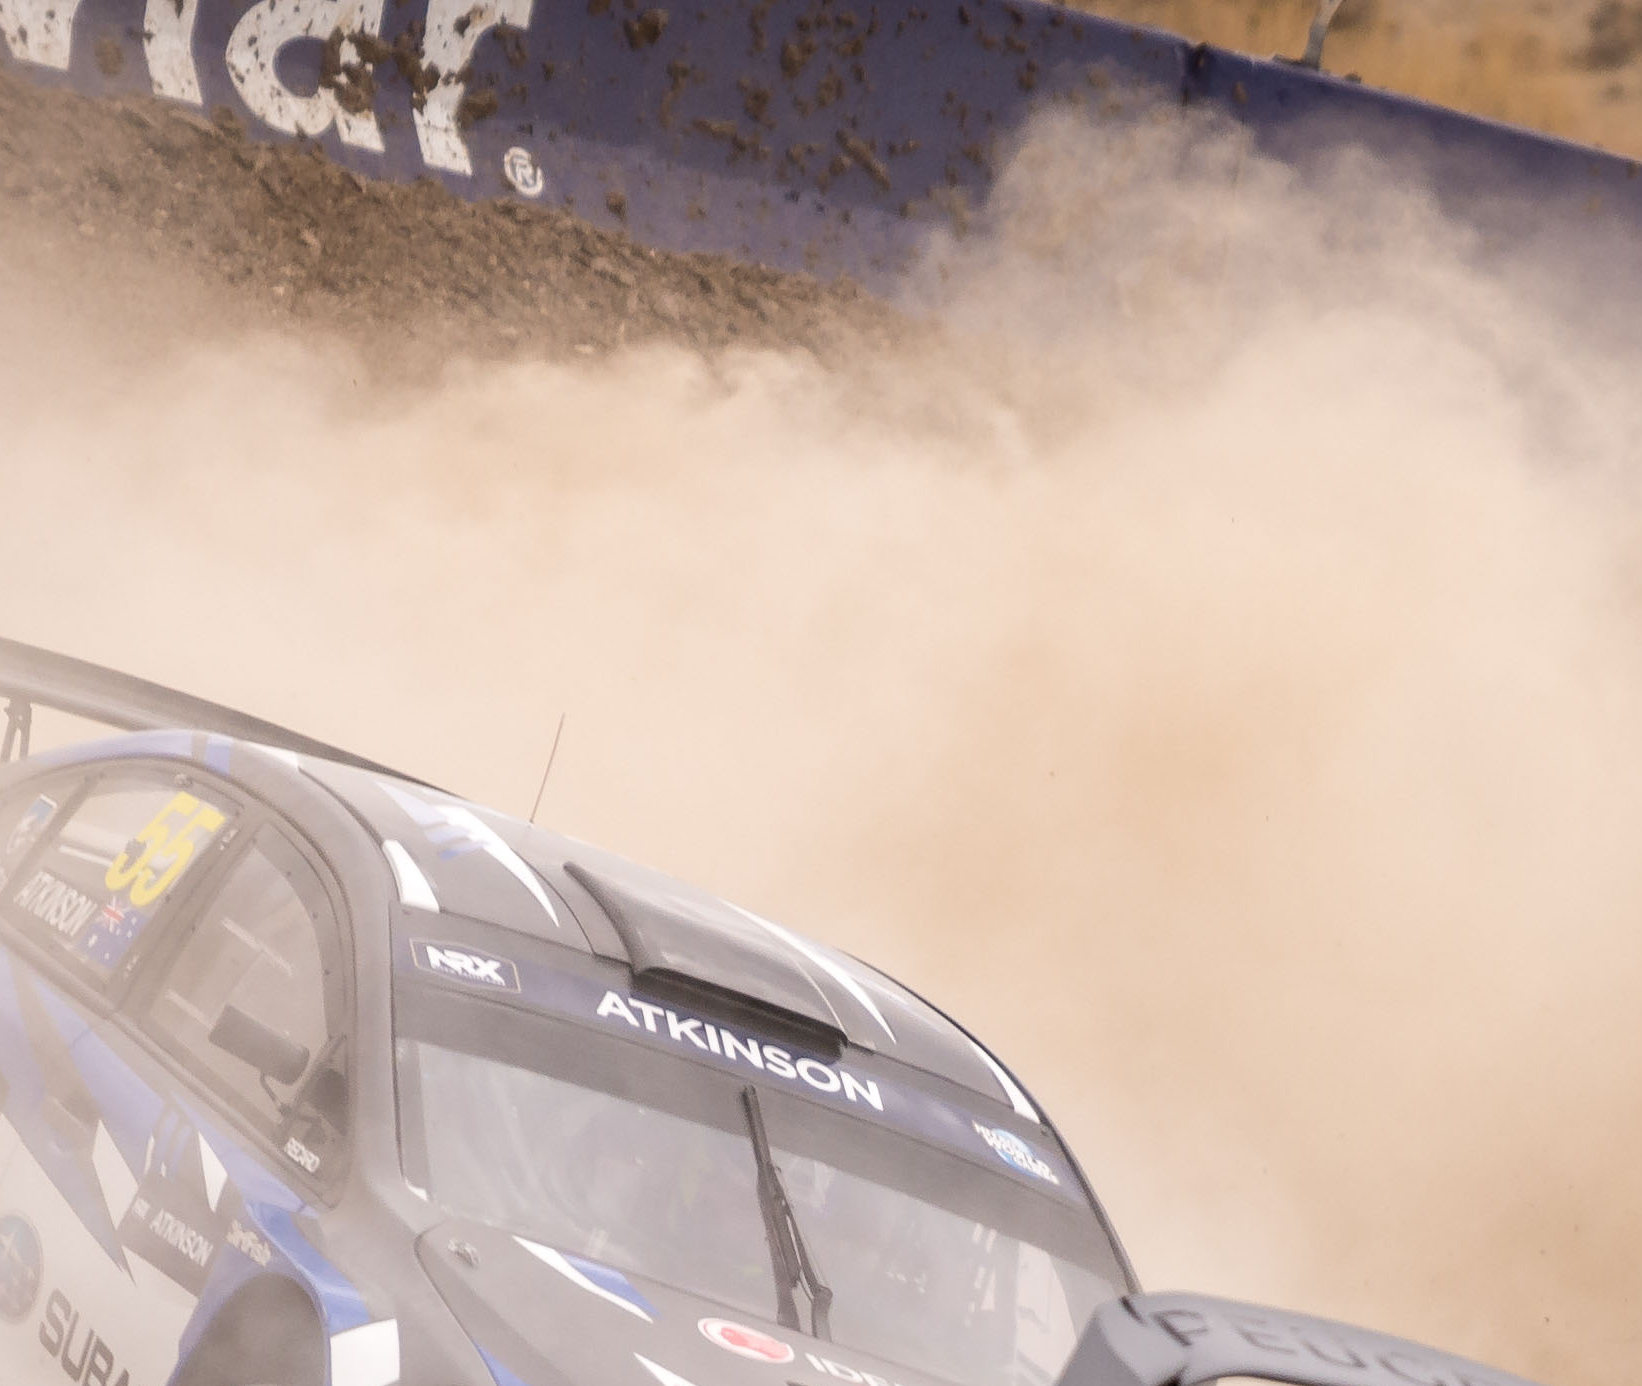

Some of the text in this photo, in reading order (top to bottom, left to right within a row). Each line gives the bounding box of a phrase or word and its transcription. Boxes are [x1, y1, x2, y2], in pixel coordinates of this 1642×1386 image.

[105, 791, 225, 907] 55
[13, 871, 98, 937] ATKINSON
[426, 945, 506, 986] NRX
[596, 990, 884, 1111] ATKINSON
[150, 1209, 214, 1267] ATKINSON
